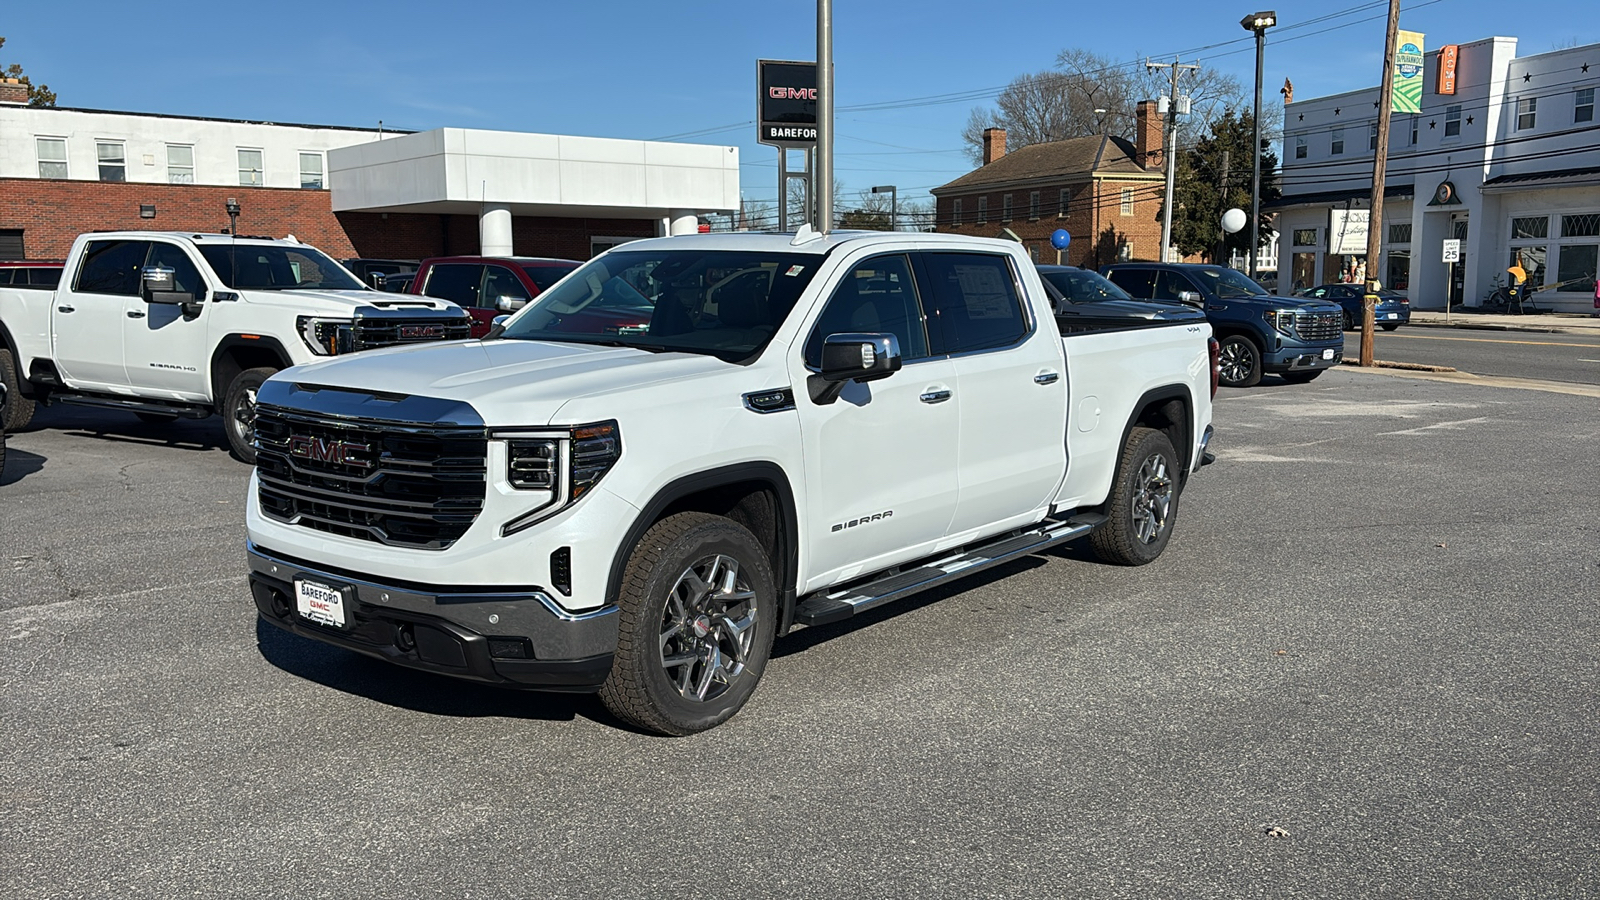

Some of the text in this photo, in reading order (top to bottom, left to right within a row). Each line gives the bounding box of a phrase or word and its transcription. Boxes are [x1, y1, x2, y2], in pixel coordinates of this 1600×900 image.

[1445, 48, 1455, 91] ACME
[770, 127, 817, 138] BAREFOR
[1445, 250, 1458, 260] 25
[402, 326, 444, 337] GMC
[290, 434, 372, 468] GMC
[831, 510, 893, 532] SIERRA
[301, 585, 339, 605] BAREFORD
[309, 600, 331, 612] GMC
